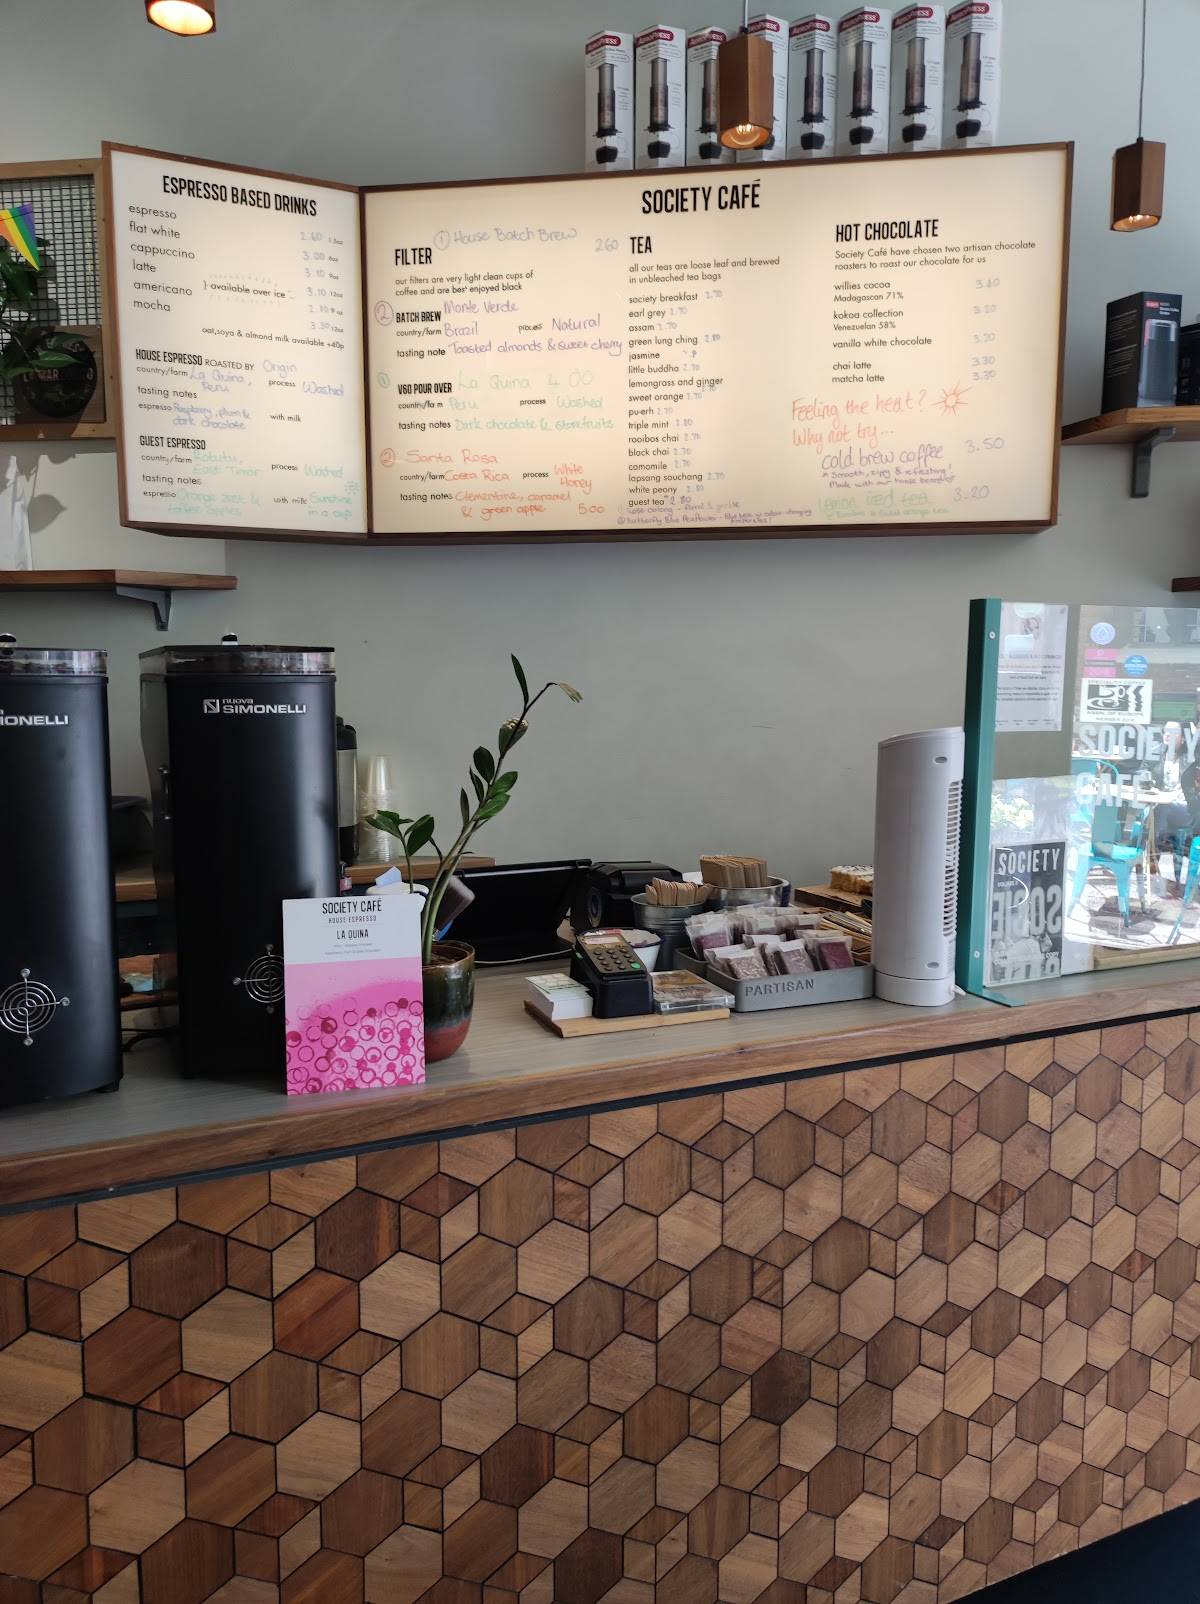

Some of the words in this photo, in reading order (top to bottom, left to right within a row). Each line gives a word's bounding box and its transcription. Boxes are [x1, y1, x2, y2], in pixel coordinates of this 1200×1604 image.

[163, 175, 227, 202] ESPRESSO
[232, 187, 270, 209] BASED
[275, 193, 317, 216] DRINKS
[642, 186, 712, 213] SOCIETY
[718, 179, 760, 209] CAFÉ
[128, 204, 177, 219] espresso
[129, 221, 146, 233] flat
[151, 225, 180, 239] white
[454, 230, 488, 242] House
[495, 228, 533, 242] Batch
[539, 228, 578, 241] Brew
[836, 224, 860, 242] HOT
[865, 219, 939, 240] CHOCOLATE
[630, 236, 652, 253] TEA
[835, 250, 864, 260] Society
[868, 248, 887, 257] Café
[891, 247, 910, 256] have
[913, 245, 942, 254] chosen
[995, 241, 1036, 250] chocolate
[131, 243, 195, 260] cappuccino
[395, 248, 432, 265] FILTER
[133, 260, 157, 272] latte
[691, 260, 711, 269] loose
[714, 258, 729, 268] leaf
[731, 258, 746, 266] and
[750, 257, 779, 266] brewed
[835, 262, 867, 270] roasters
[880, 260, 900, 268] roast
[920, 257, 960, 266] chocolate
[410, 274, 429, 284] filters
[446, 275, 463, 284] very
[465, 273, 481, 283] light
[483, 272, 503, 280] clean
[506, 273, 524, 282] cups
[639, 273, 684, 283] unbleached
[702, 272, 721, 281] bags
[134, 281, 193, 296] americano
[211, 283, 250, 294] available
[252, 289, 271, 297] over
[274, 289, 286, 299] ice
[395, 286, 417, 296] coffee
[420, 286, 435, 295] and
[470, 283, 500, 294] enjoyed
[502, 282, 522, 291] black
[834, 281, 861, 290] willies
[629, 295, 657, 304] society
[660, 292, 698, 302] breakfast
[834, 293, 883, 303] Madagascan
[133, 299, 170, 312] mocha
[396, 312, 419, 323] BATCH
[421, 311, 441, 322] BREW
[629, 309, 644, 318] earl
[648, 309, 665, 319] grey
[834, 311, 860, 320] kokoa
[863, 309, 903, 319] collection
[552, 313, 601, 331] Natural
[629, 324, 654, 332] assam
[833, 323, 876, 331] Venezuelan
[396, 328, 442, 337] country/farm
[444, 322, 478, 337] Brazil
[246, 331, 273, 341] almond
[275, 334, 289, 342] milk
[292, 336, 324, 347] available
[629, 339, 652, 348] green
[655, 336, 672, 346] lung
[675, 335, 698, 345] ching
[833, 338, 861, 348] vanilla
[864, 338, 887, 347] white
[890, 337, 932, 346] chocolate
[498, 340, 542, 353] almonds
[136, 349, 161, 362] HOUSE
[163, 352, 202, 366] ESPRESSO
[205, 359, 242, 370] ROASTED
[397, 349, 424, 359] tasting
[629, 352, 660, 362] jasmine
[136, 365, 188, 377] country/farm
[629, 365, 645, 374] little
[648, 364, 679, 373] buddha
[833, 361, 850, 370] chai
[853, 361, 872, 369] latte
[268, 379, 296, 388] process
[629, 379, 674, 389] lemongrass
[678, 377, 693, 386] and
[696, 378, 723, 388] ginger
[832, 374, 863, 383] matcha
[866, 374, 885, 382] latte
[137, 386, 170, 398] tasting
[172, 389, 197, 399] notes
[398, 384, 412, 394] V60
[414, 383, 432, 394] POUR
[434, 383, 452, 393] OVER
[629, 394, 651, 402] sweet
[655, 393, 684, 402] orange
[138, 402, 172, 411] espresso
[288, 414, 301, 422] milk
[792, 399, 839, 429] Feeling
[846, 400, 869, 414] the
[398, 422, 425, 431] tasting
[429, 421, 451, 429] notes
[629, 421, 649, 430] triple
[652, 420, 669, 429] mint
[140, 436, 164, 448] GUEST
[167, 437, 205, 450] ESPRESSO
[629, 435, 659, 443] rooibos
[662, 433, 679, 441] chai
[793, 429, 823, 454] Why
[828, 424, 850, 444] not
[966, 437, 1004, 453] 3.50
[407, 451, 452, 463] Santa
[463, 450, 498, 463] Rosa
[629, 448, 650, 456] black
[653, 447, 669, 456] chai
[822, 447, 853, 470] cold
[860, 448, 893, 466] brew
[900, 444, 943, 467] coffee
[629, 462, 667, 471] camomile
[142, 474, 173, 485] tasting
[177, 476, 202, 485] notes
[400, 472, 445, 482] country/farm
[482, 470, 511, 481] Rica
[523, 471, 549, 479] process
[629, 475, 661, 483] lapsang
[629, 486, 650, 494] white
[400, 493, 427, 502] tasting
[629, 498, 649, 506] guest
[482, 506, 512, 520] green
[223, 705, 306, 714] SIMONELLI
[1079, 724, 1200, 763] SOCIETY
[998, 848, 1060, 875] SOCIETY
[322, 901, 357, 914] SOCIETY
[361, 898, 382, 912] CAFÉ
[349, 915, 377, 923] ESPRESSO
[337, 930, 346, 939] LA
[745, 979, 814, 997] PARTISAN
